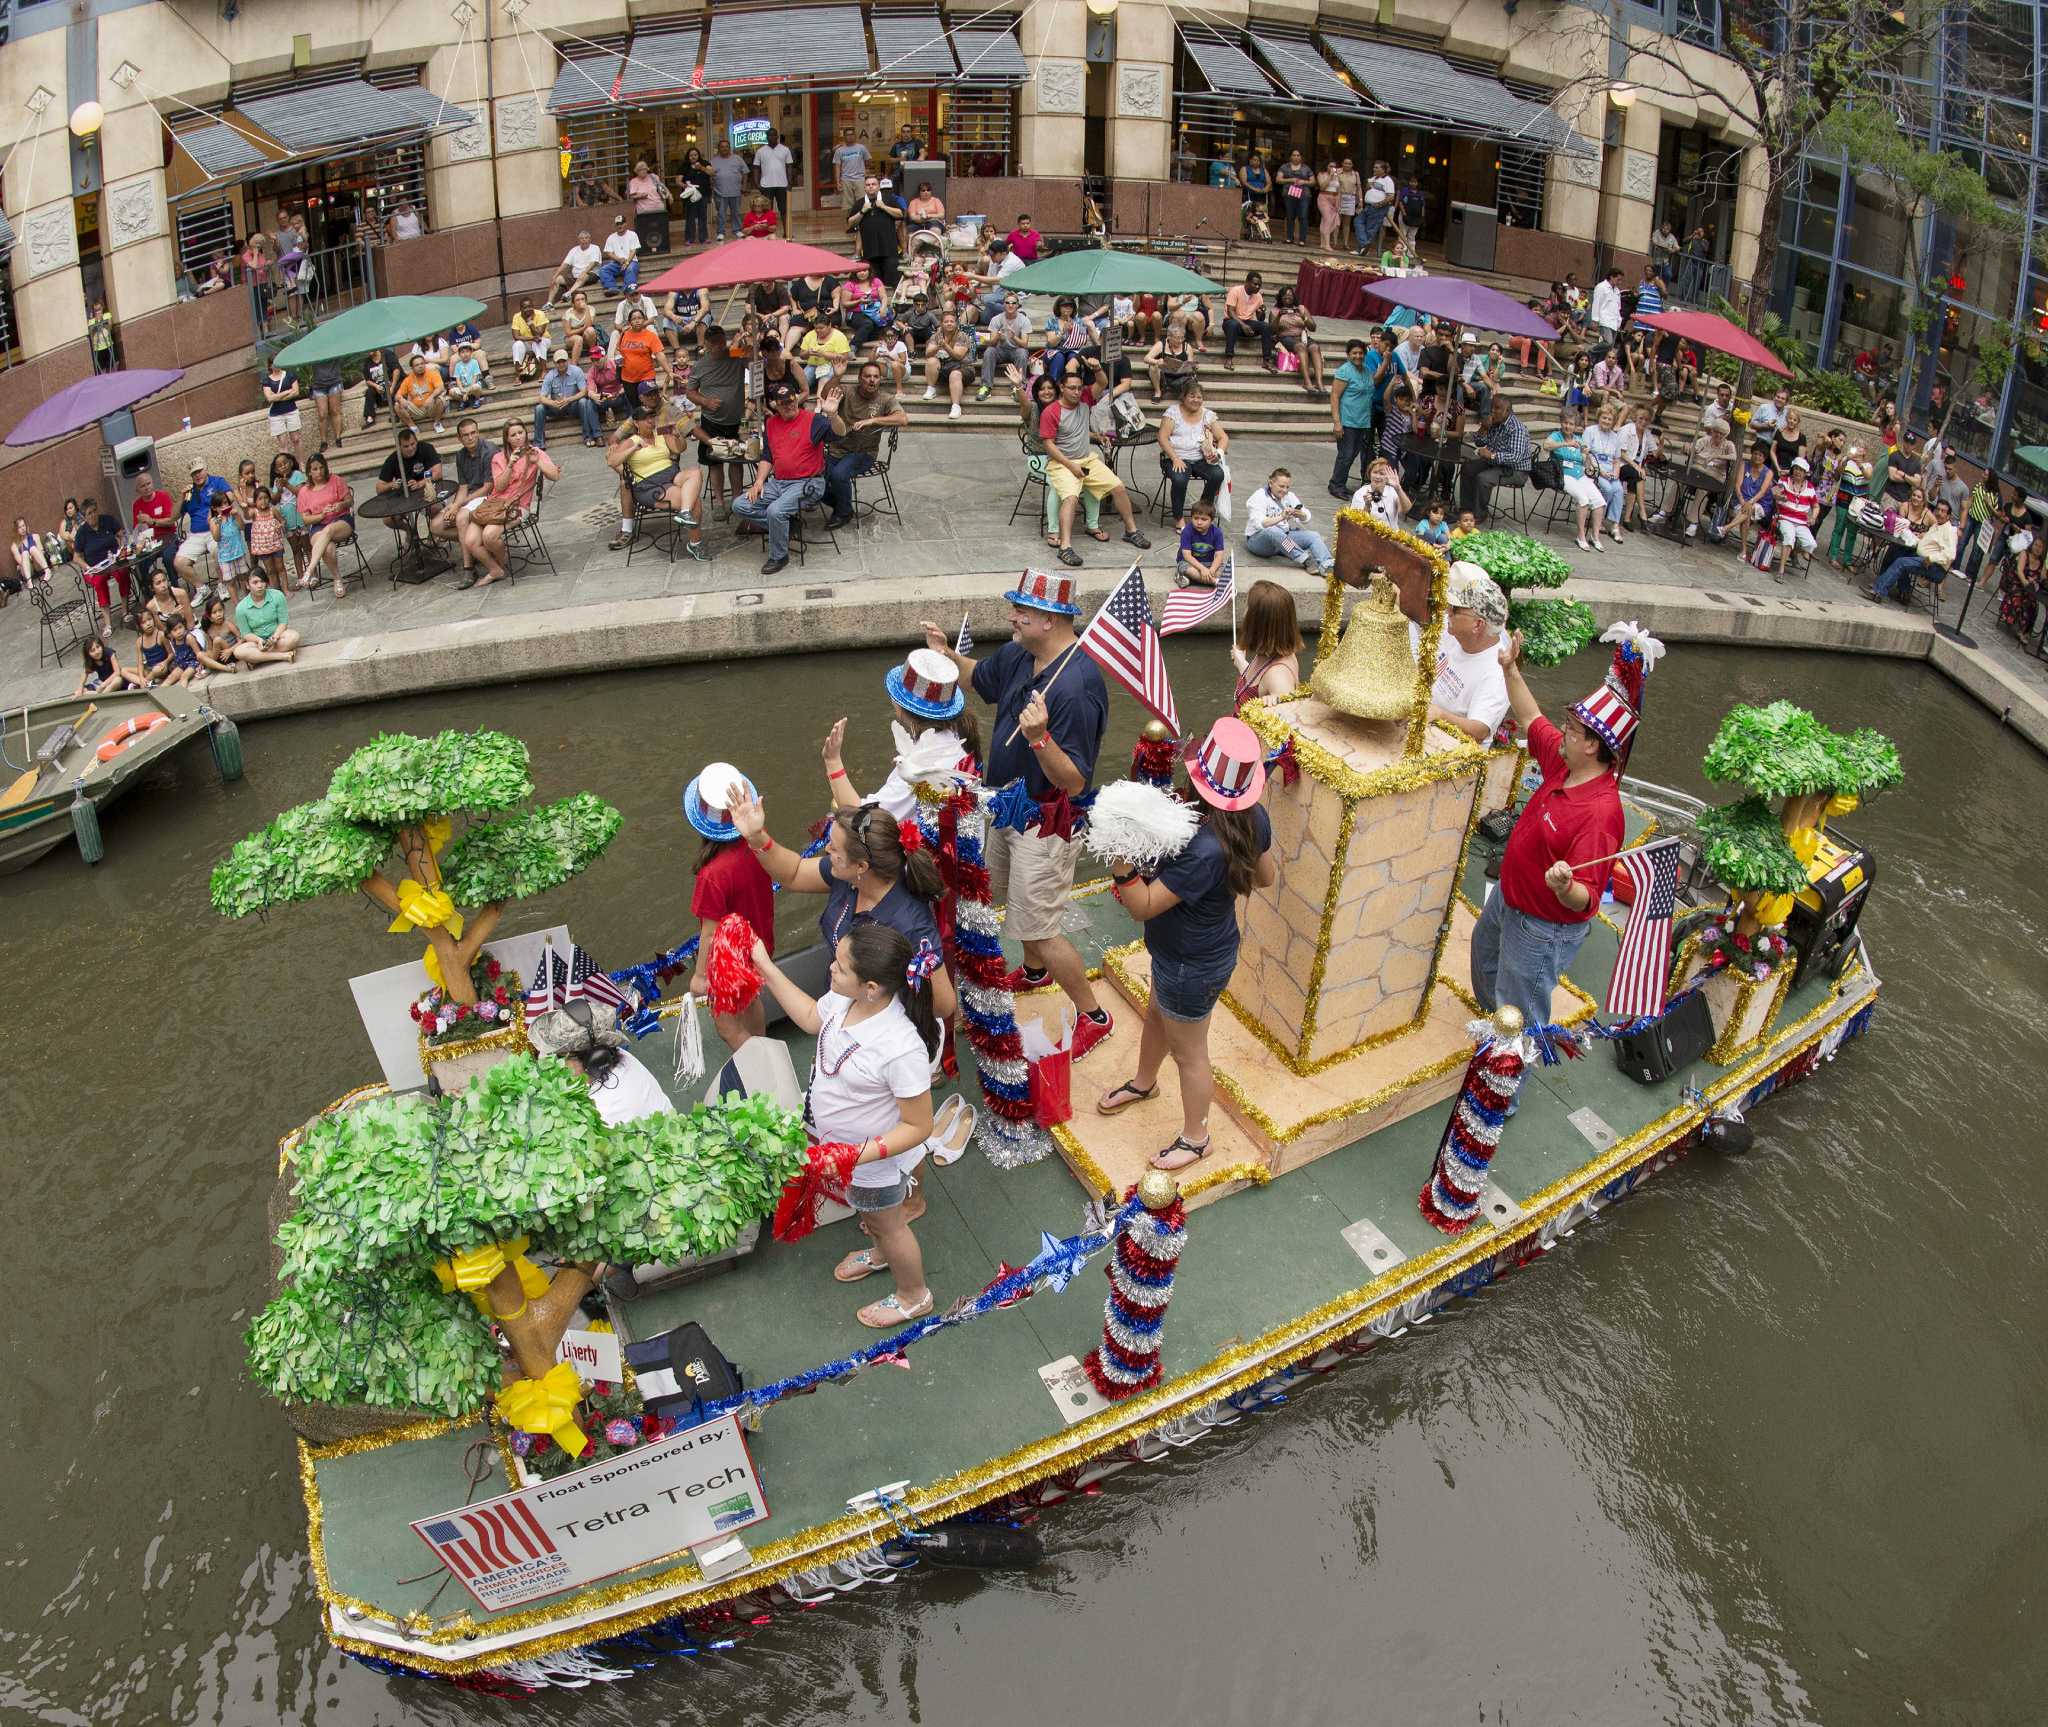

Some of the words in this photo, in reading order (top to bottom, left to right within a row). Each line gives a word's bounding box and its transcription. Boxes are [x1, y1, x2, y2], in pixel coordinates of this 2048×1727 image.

[536, 1480, 586, 1503] Float
[589, 1440, 694, 1485] Sponsored
[698, 1426, 731, 1446] By:
[556, 1501, 651, 1539] Tetra
[656, 1464, 746, 1505] Tech
[472, 1553, 563, 1587] AMERICA'S
[477, 1576, 518, 1593] ARMED
[519, 1561, 568, 1581] FORCES
[480, 1583, 519, 1599] RIVER
[520, 1566, 572, 1588] PARADE
